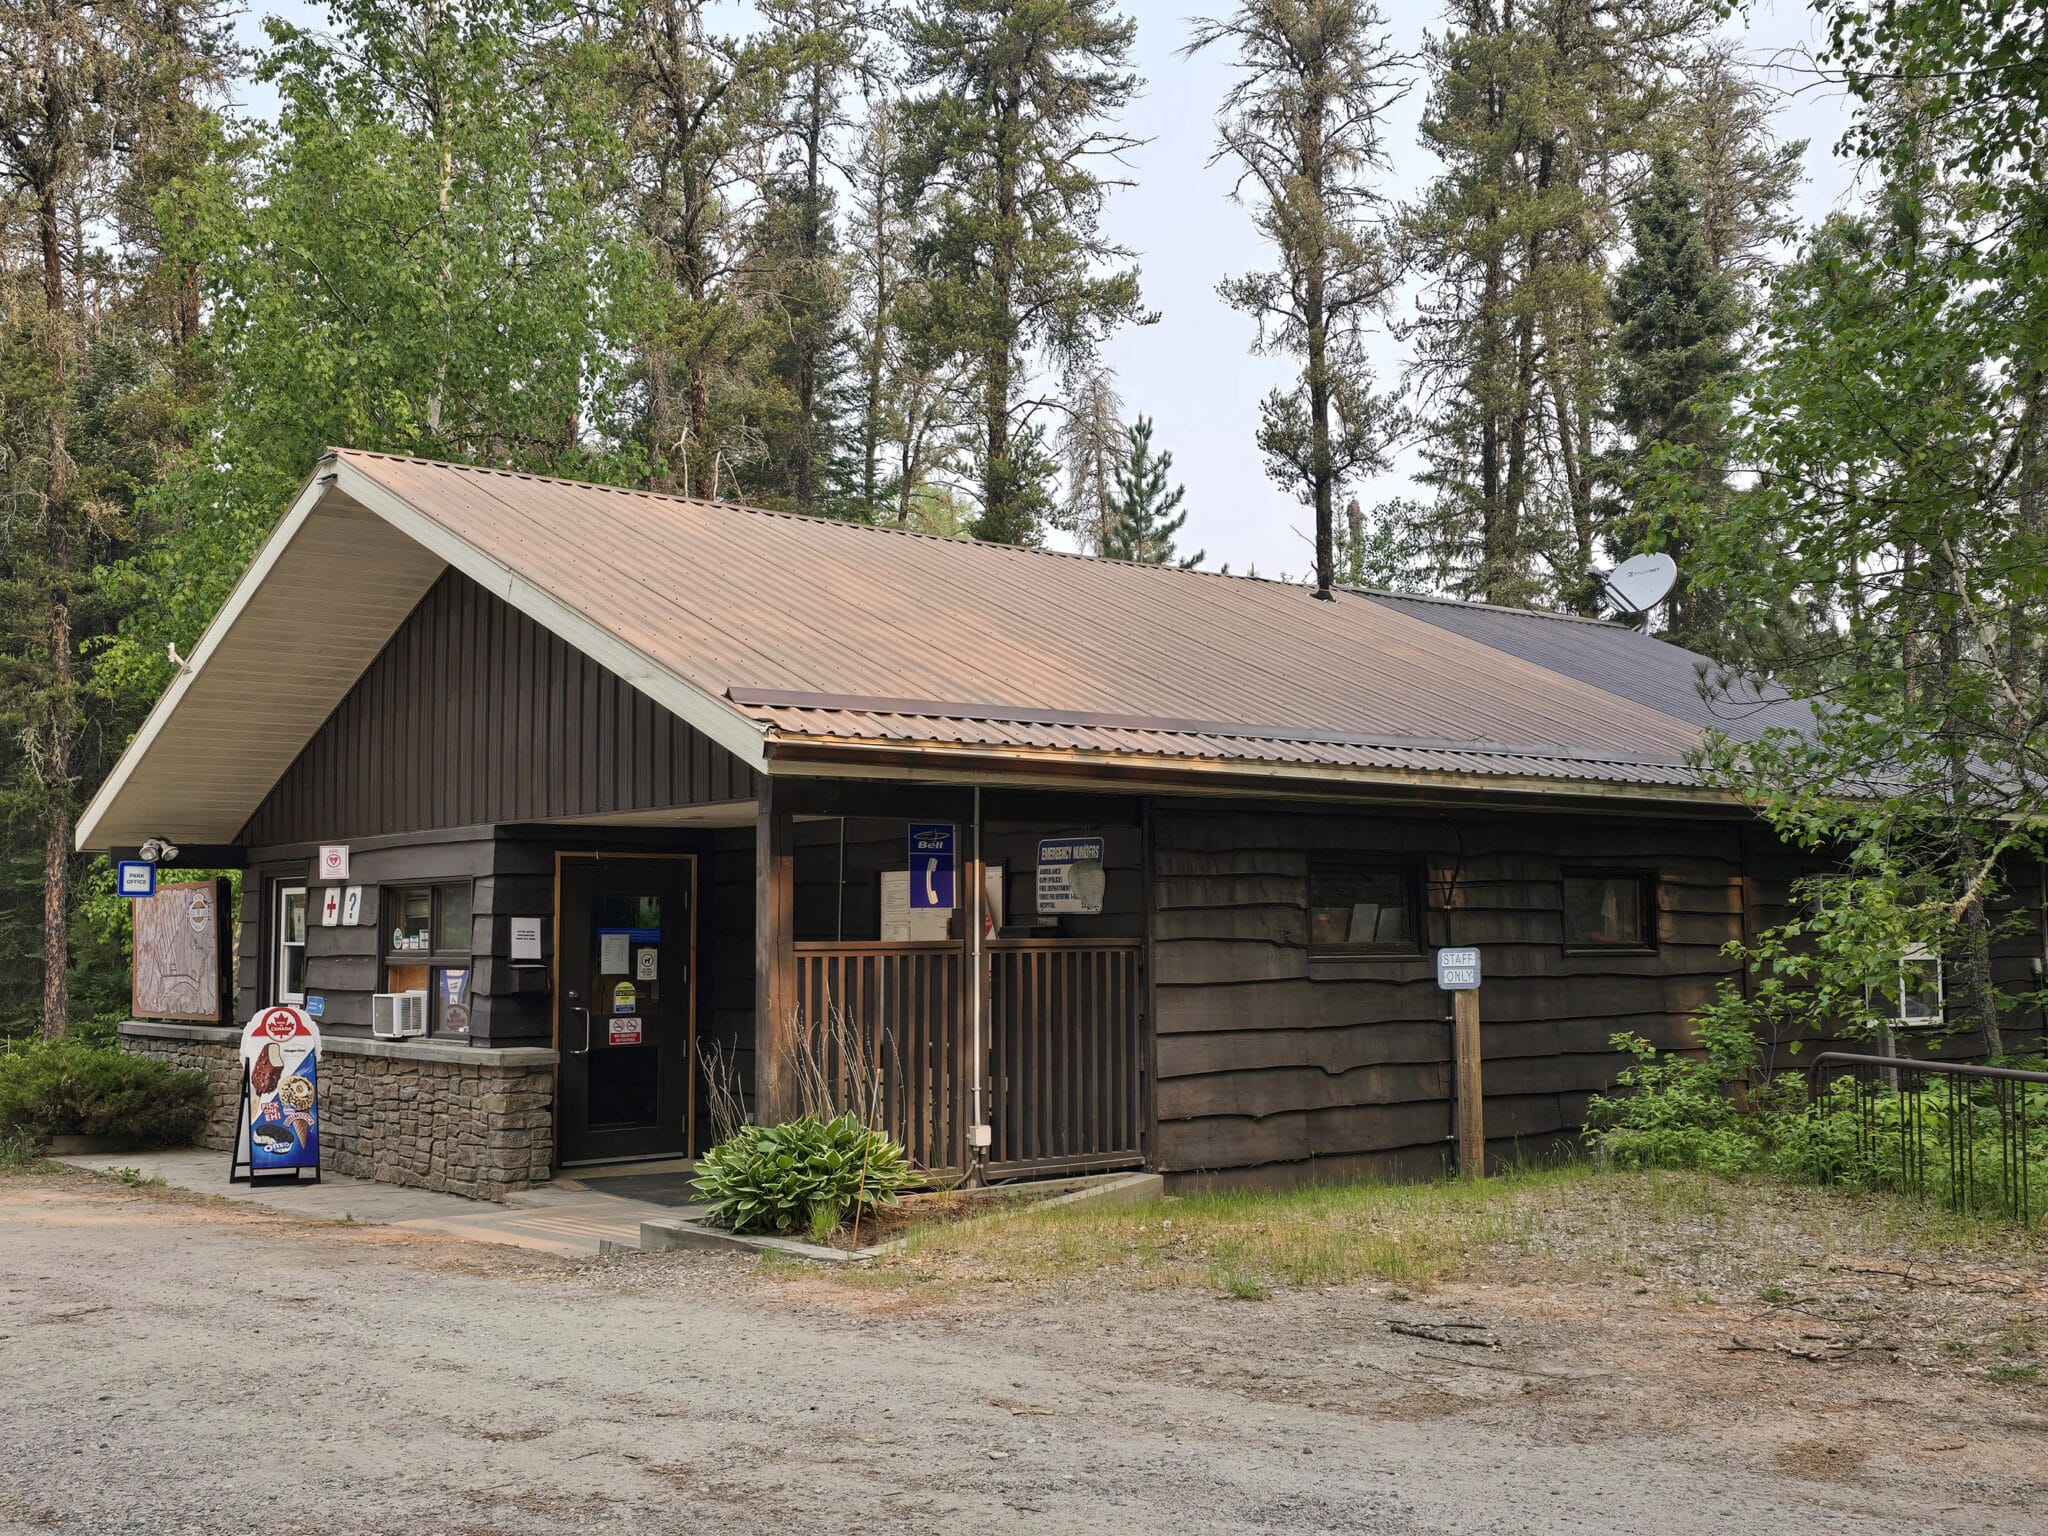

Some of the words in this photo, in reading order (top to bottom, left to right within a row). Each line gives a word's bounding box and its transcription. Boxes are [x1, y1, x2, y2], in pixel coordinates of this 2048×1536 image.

[918, 841, 943, 849] Bell
[1041, 846, 1072, 860] EMERGENCY
[1073, 845, 1100, 859] NUMBERS
[1443, 953, 1472, 965] STAFF
[1446, 970, 1472, 983] ONLY
[261, 1102, 279, 1110] PICK
